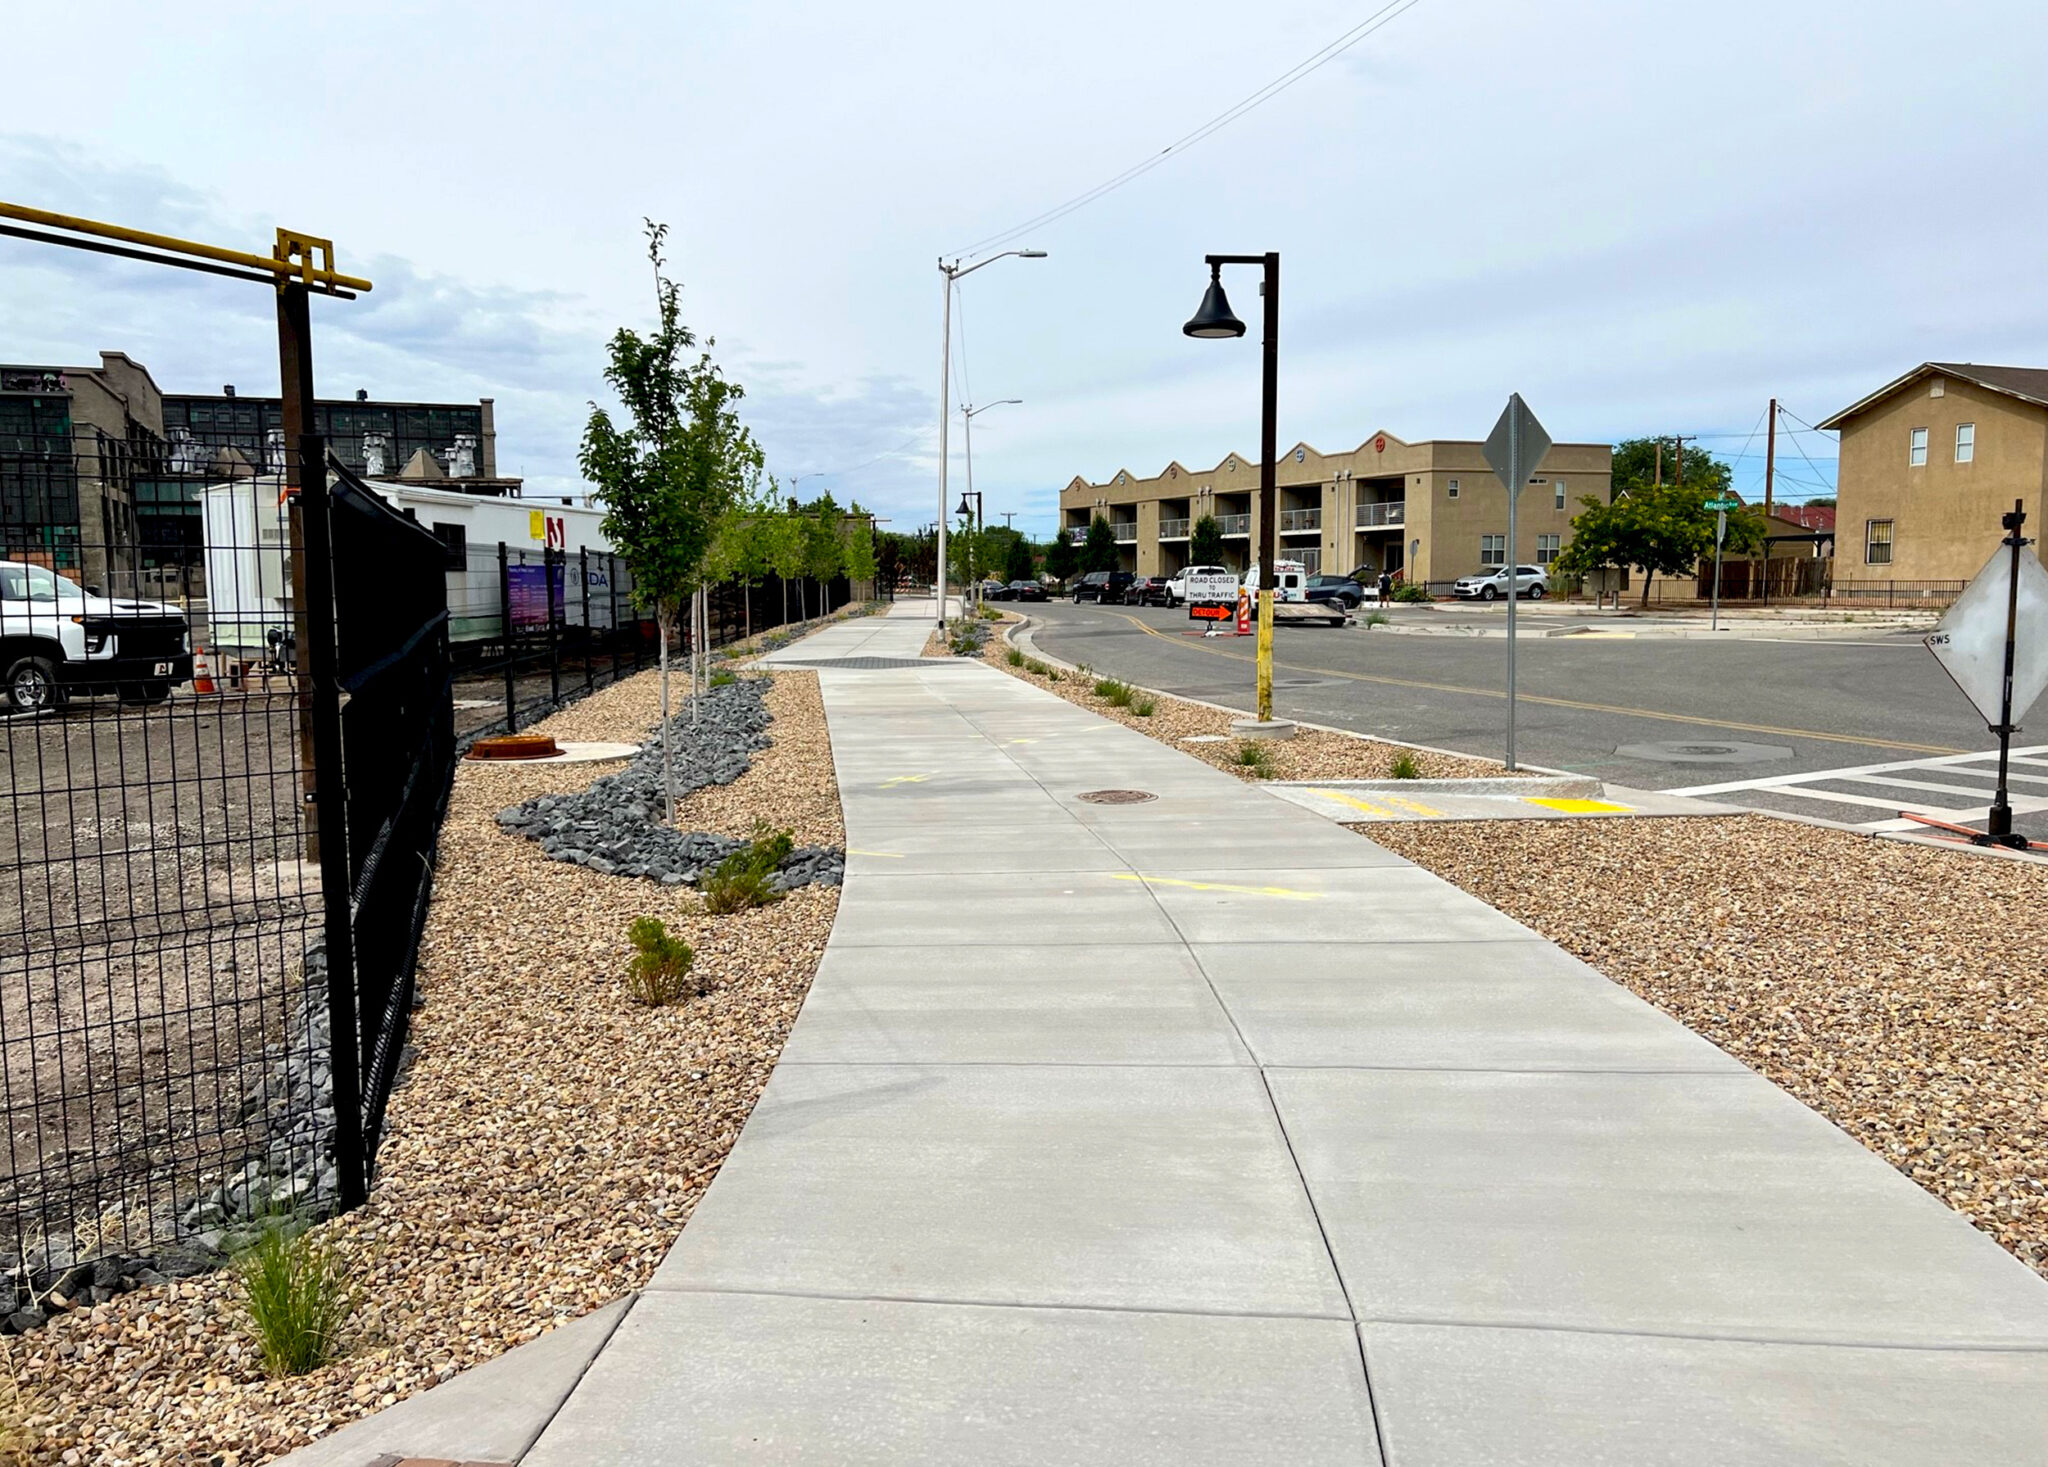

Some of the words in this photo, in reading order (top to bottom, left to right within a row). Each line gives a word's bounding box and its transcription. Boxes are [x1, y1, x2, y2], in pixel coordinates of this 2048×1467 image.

[1703, 501, 1728, 511] Atlantic
[1192, 608, 1219, 616] DETOUR
[1930, 634, 1950, 645] SWS
